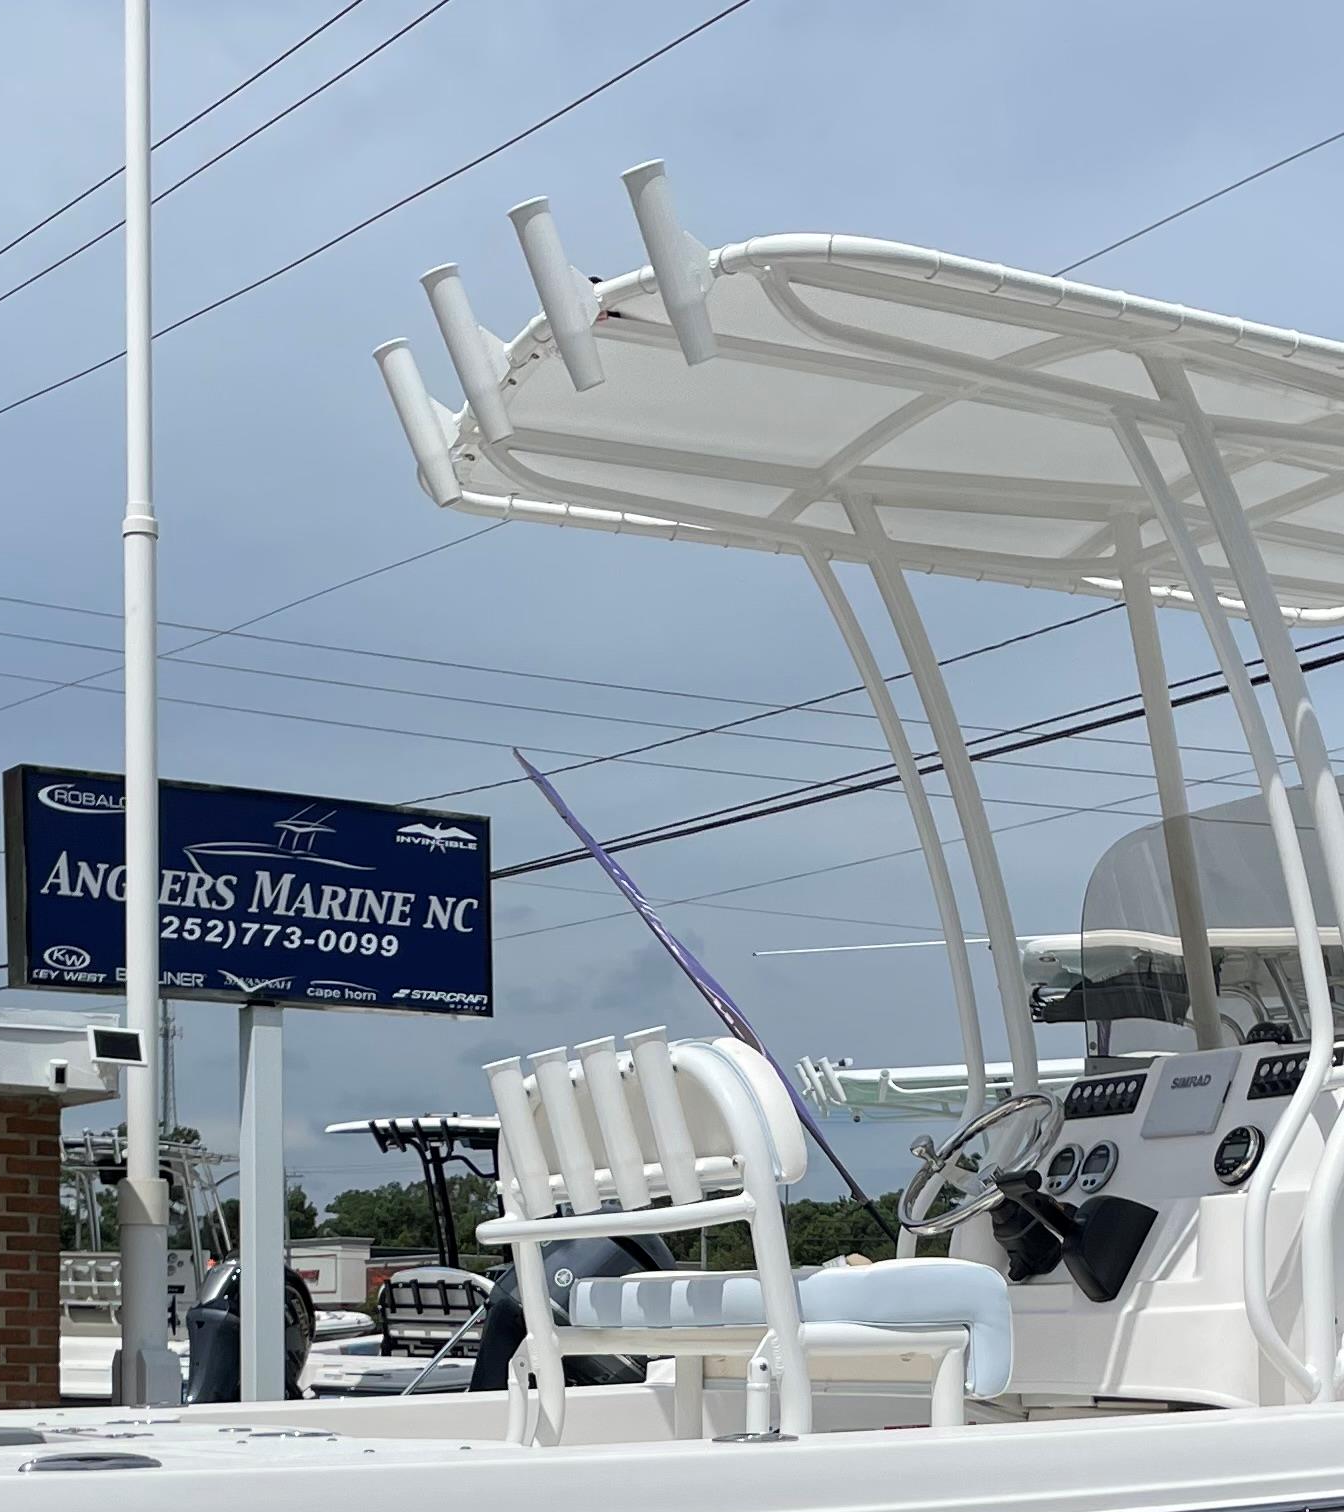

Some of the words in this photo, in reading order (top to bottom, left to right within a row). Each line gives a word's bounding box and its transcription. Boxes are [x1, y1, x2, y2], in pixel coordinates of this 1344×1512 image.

[396, 835, 478, 851] INVINCIBLE
[40, 850, 238, 911] ANGERS
[248, 870, 416, 927] MARINE
[422, 895, 479, 933] NC
[160, 915, 399, 957] 252)773-0099
[115, 967, 205, 988] BINER
[1170, 1074, 1212, 1090] SIMRAD
